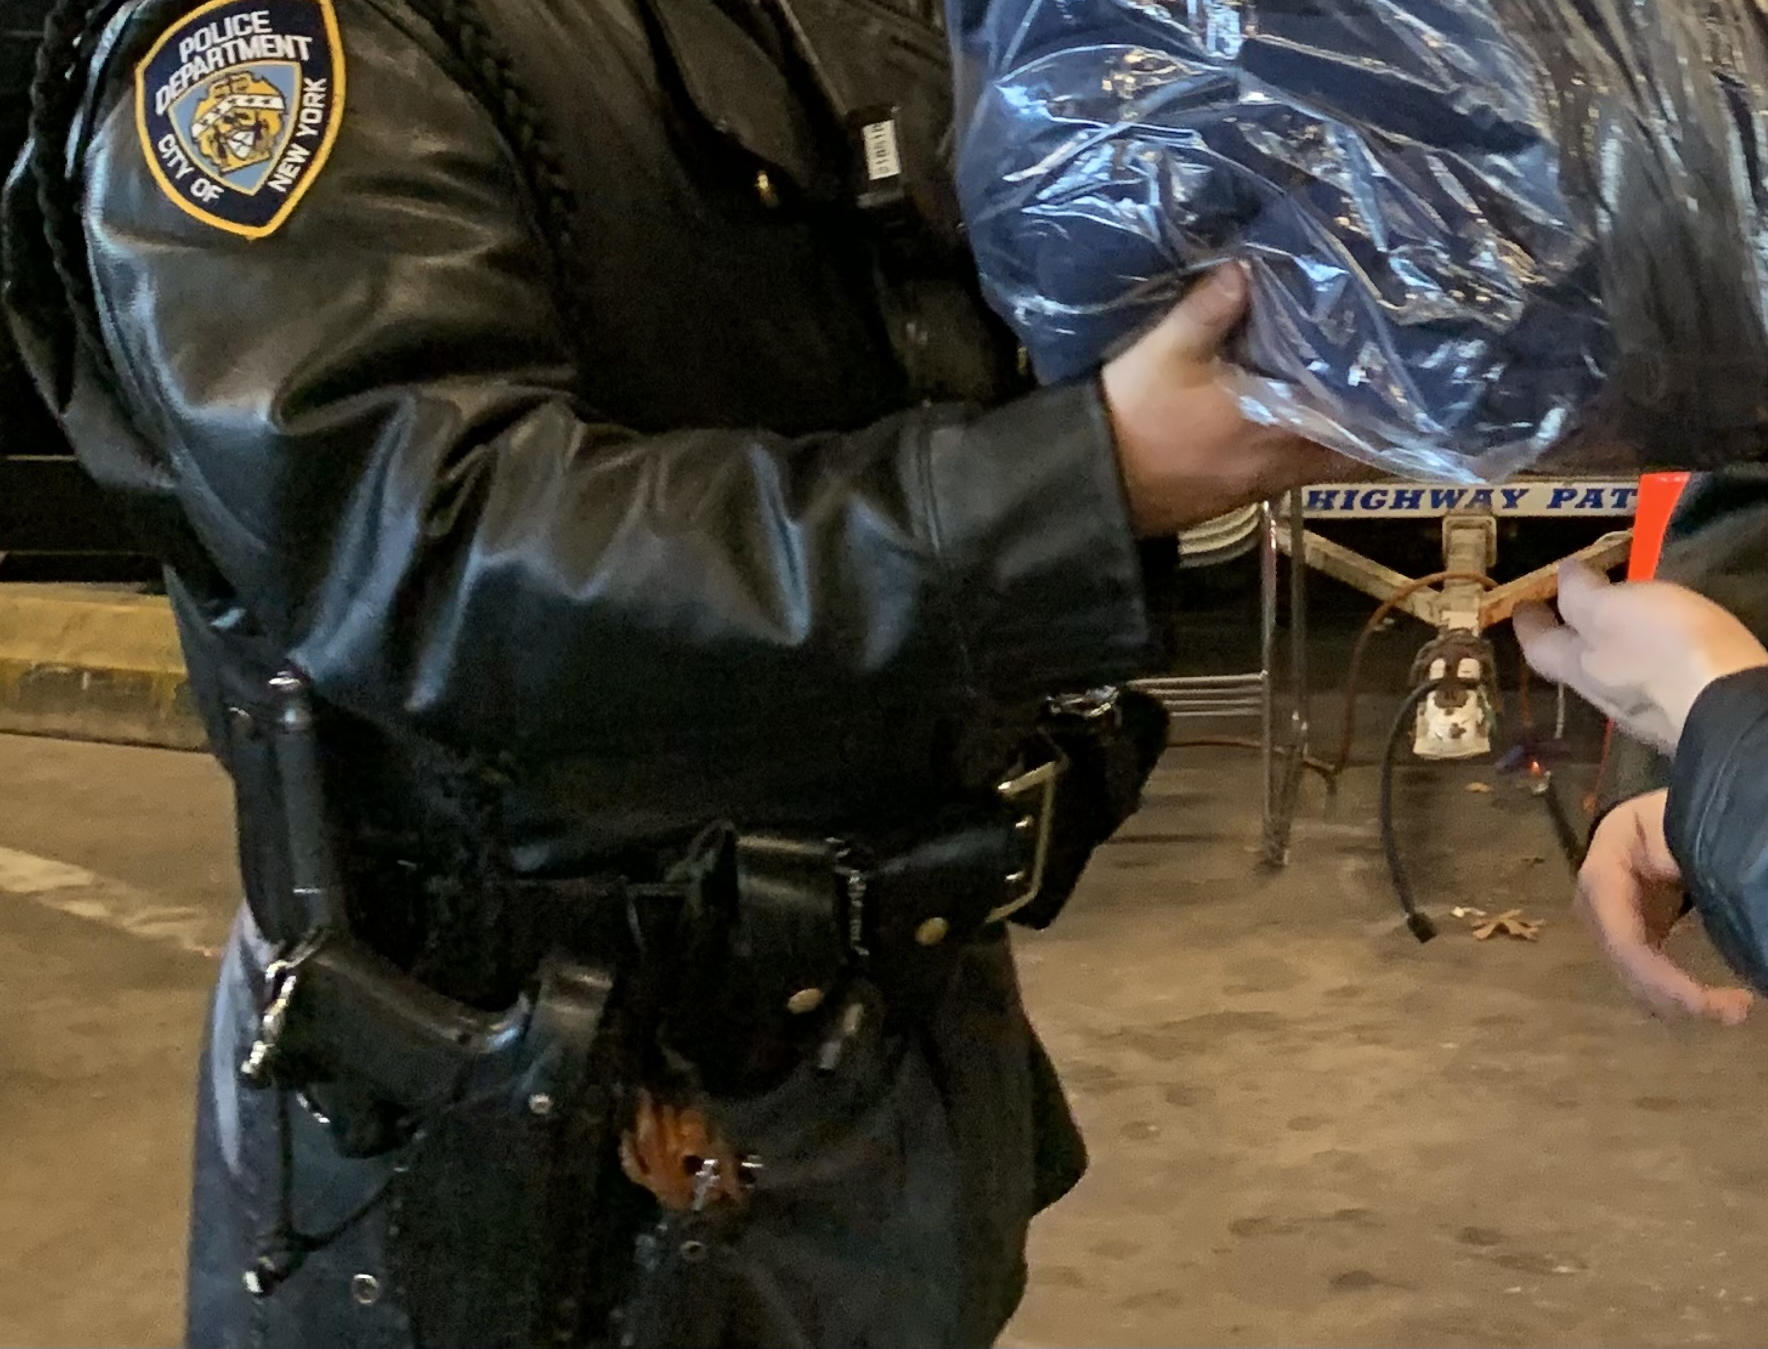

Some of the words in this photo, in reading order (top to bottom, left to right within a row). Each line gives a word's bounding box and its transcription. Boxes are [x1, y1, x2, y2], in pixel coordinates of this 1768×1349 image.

[179, 10, 273, 63] POLICE
[155, 34, 313, 116] DEPARTMENT
[158, 133, 195, 180] CITY
[190, 177, 225, 203] OF
[267, 144, 311, 193] NEW
[296, 77, 327, 138] YORK
[1304, 488, 1530, 511] HIGHWAY
